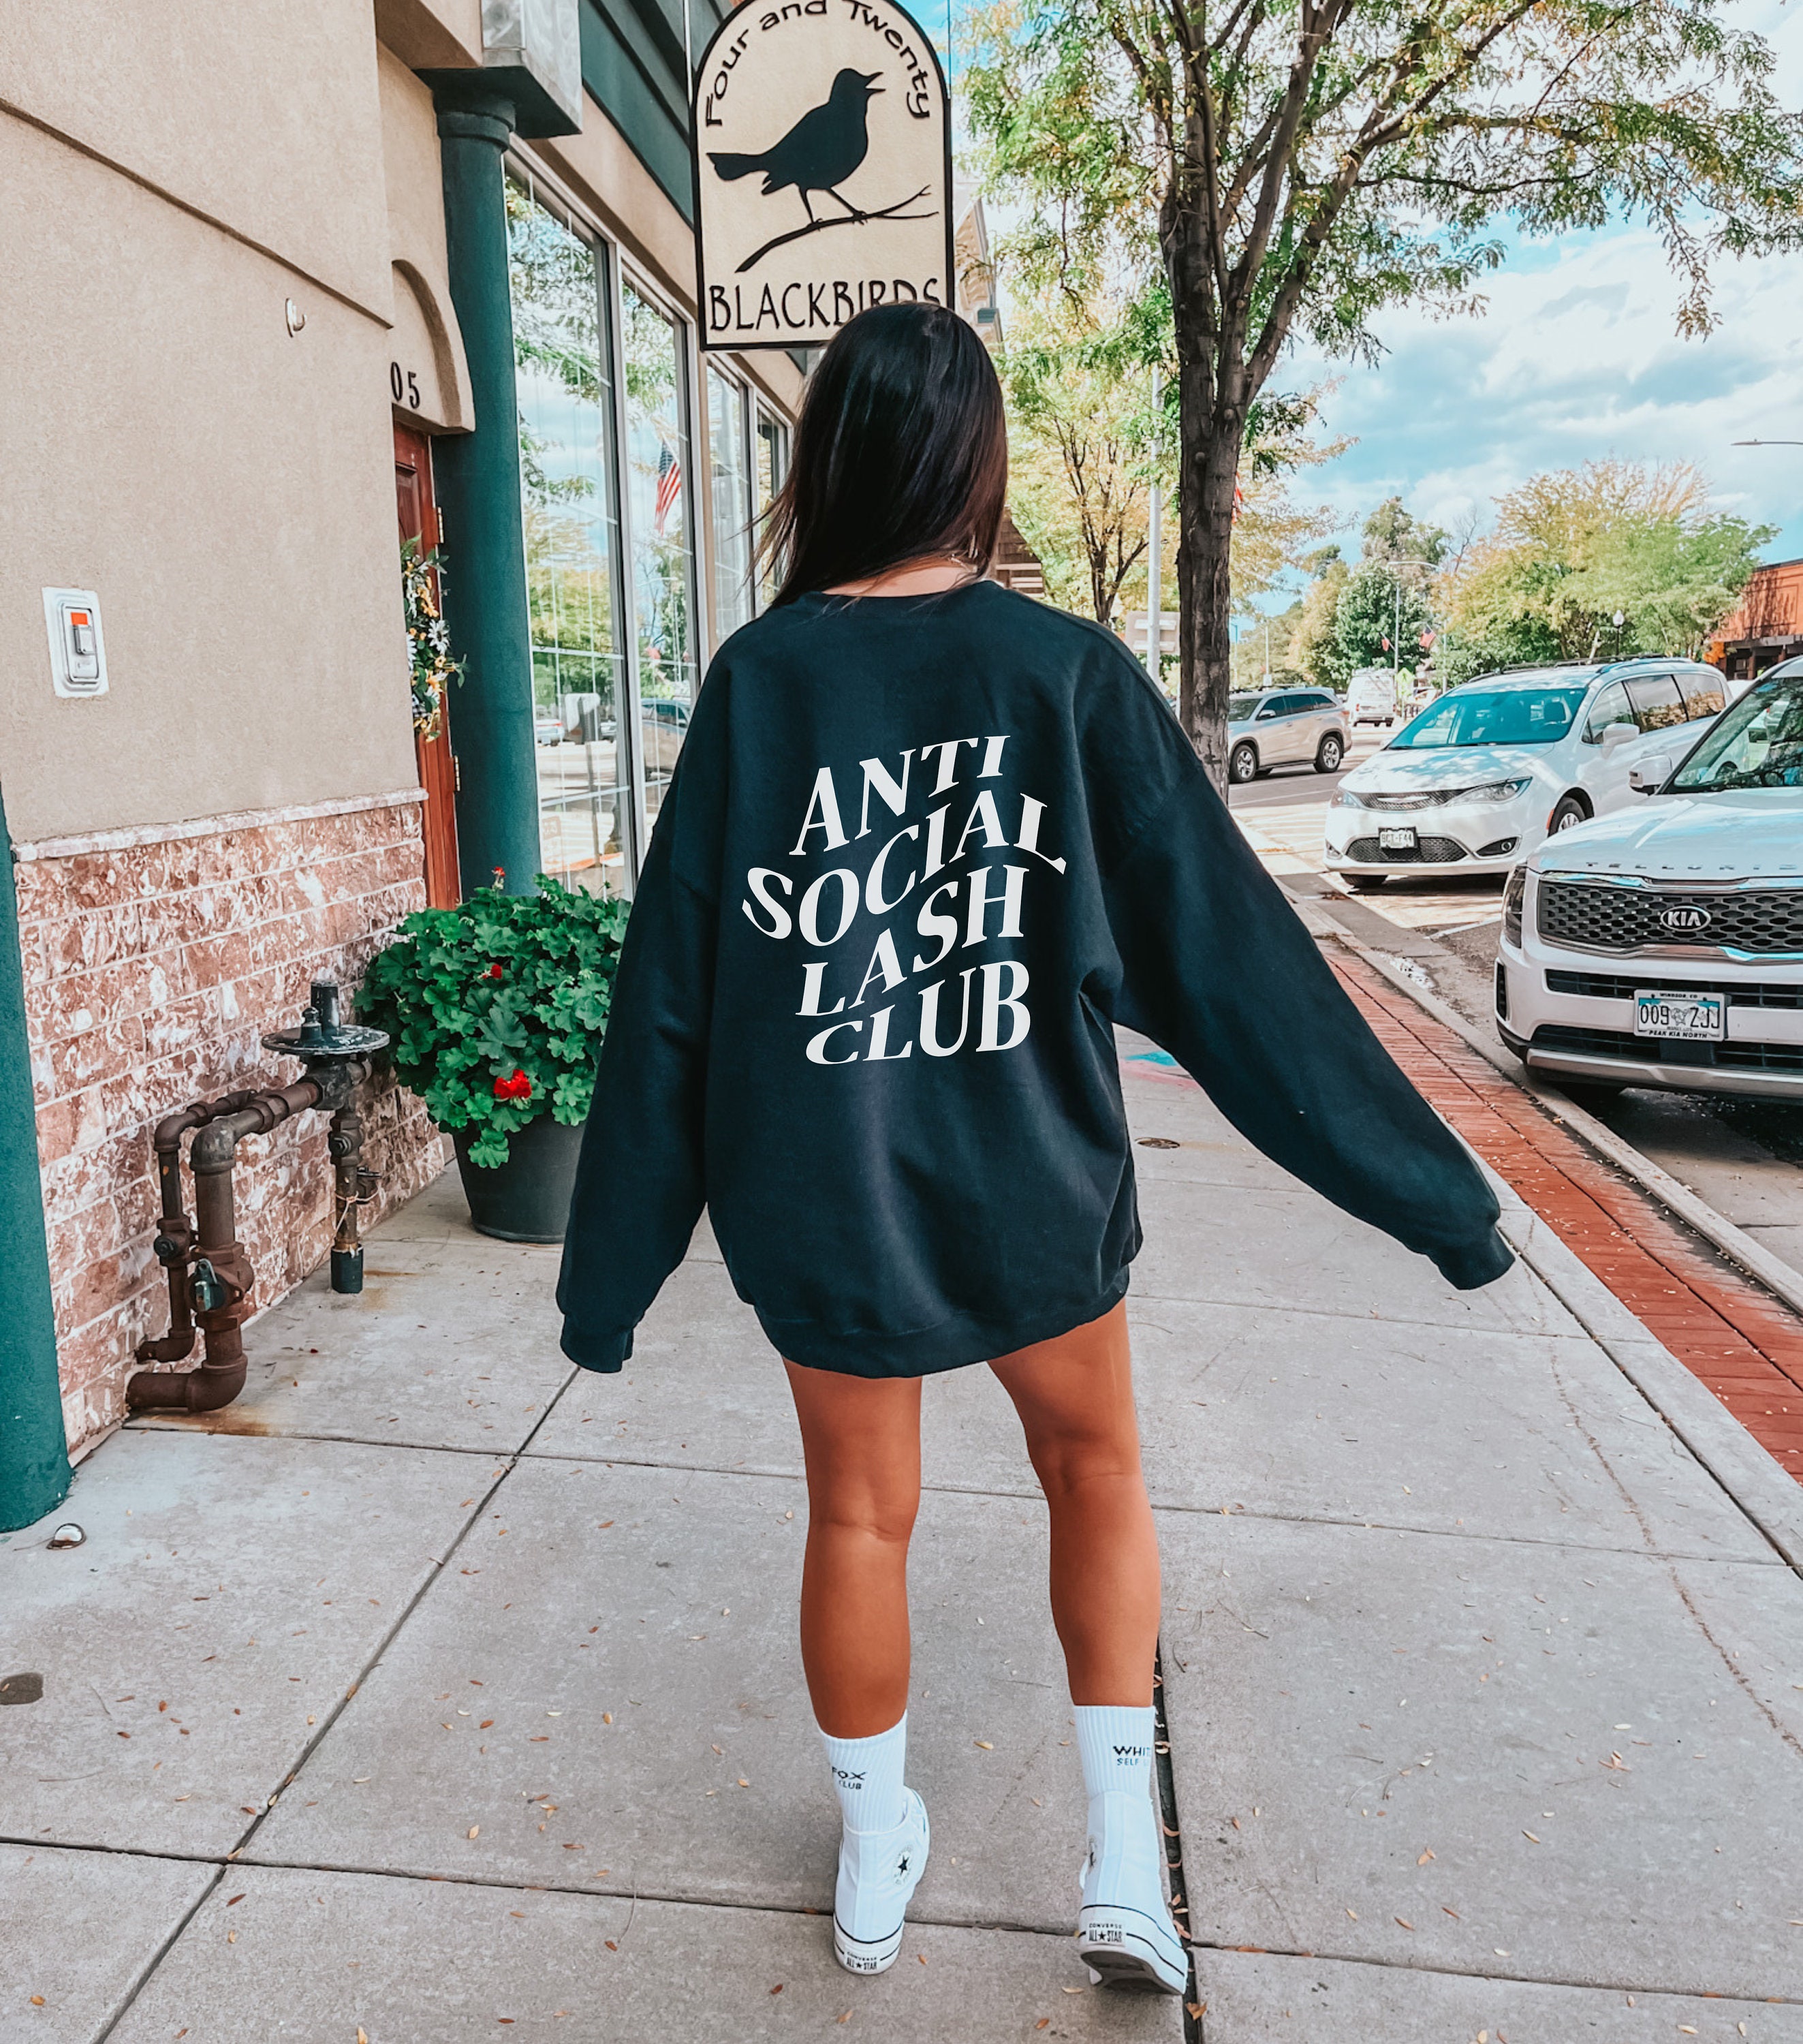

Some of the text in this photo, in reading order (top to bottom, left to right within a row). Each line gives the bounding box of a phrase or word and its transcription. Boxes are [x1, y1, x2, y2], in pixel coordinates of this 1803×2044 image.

[706, 0, 930, 127] Four and Twenty
[789, 735, 1011, 856] ANTI
[742, 790, 1067, 947] SOCIAL
[1667, 911, 1702, 927] KIA
[796, 864, 1029, 1017] LASH
[806, 961, 1031, 1065] CLUB
[1640, 1004, 1669, 1025] 009
